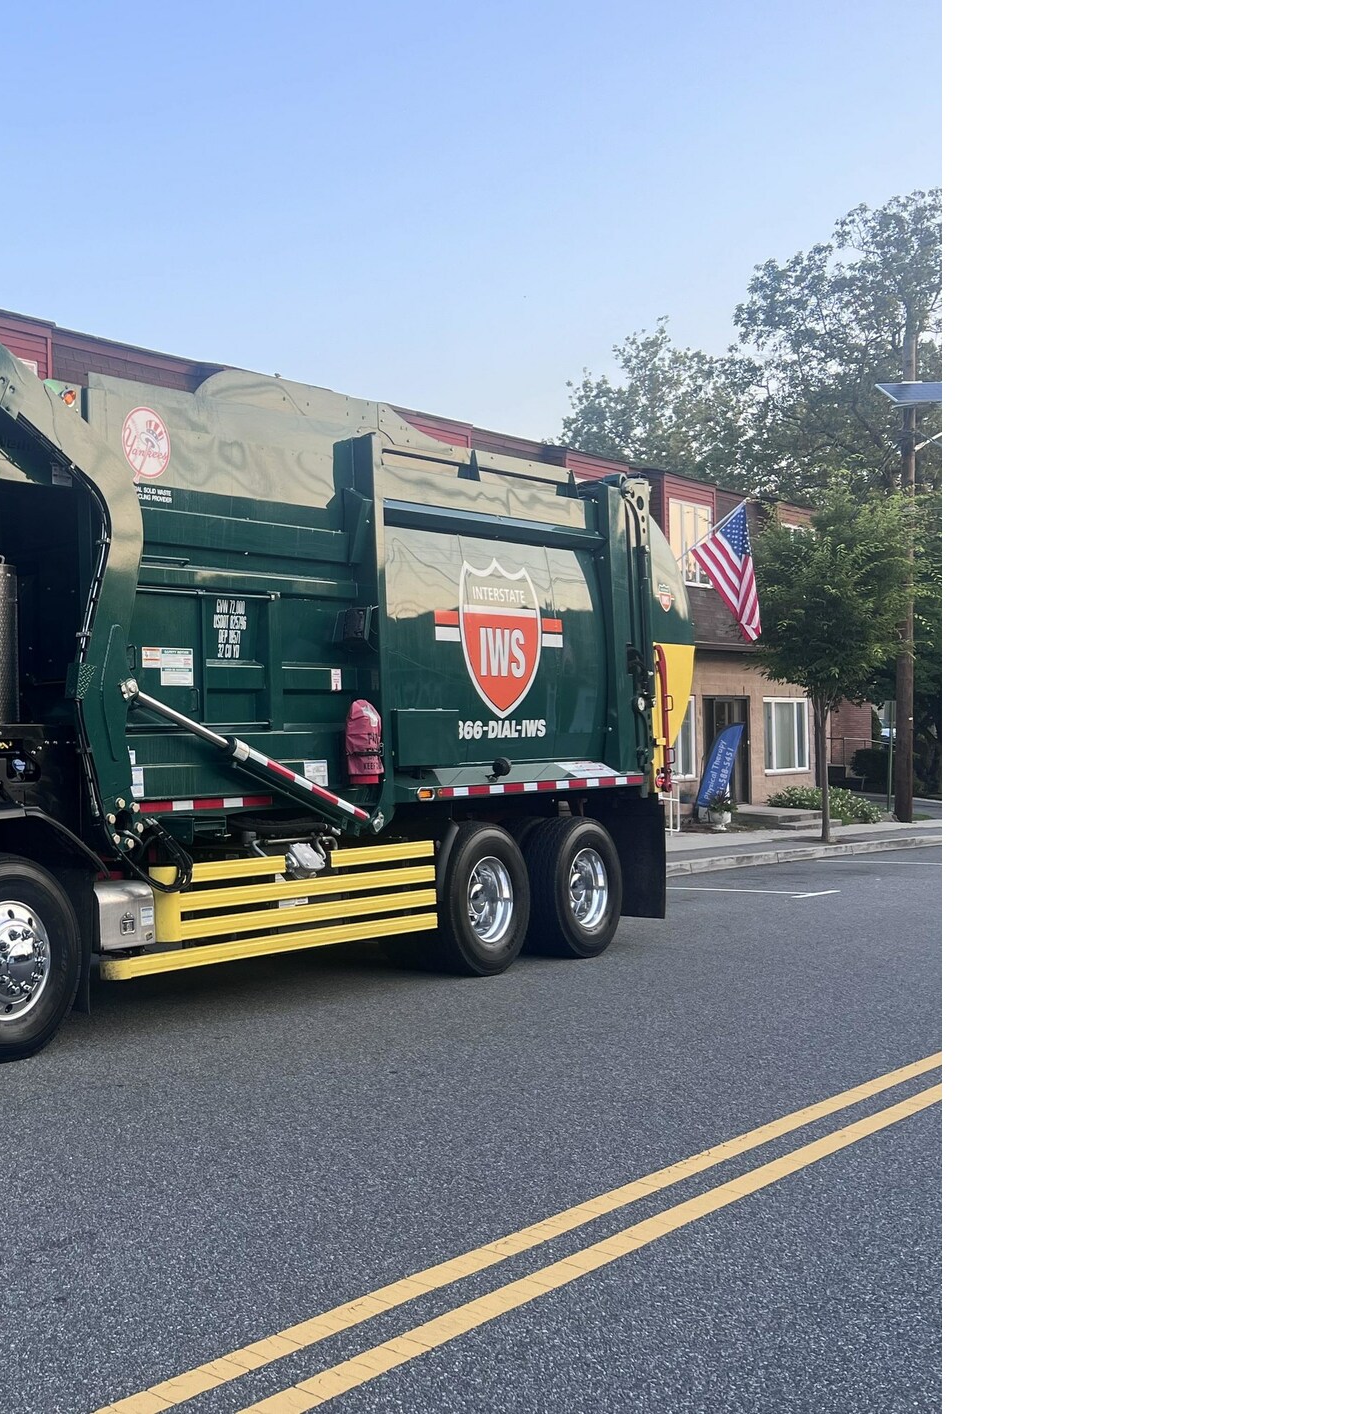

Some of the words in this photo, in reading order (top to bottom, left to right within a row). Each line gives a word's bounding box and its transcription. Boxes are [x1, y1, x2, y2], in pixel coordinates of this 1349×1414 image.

[124, 424, 168, 460] Yankees
[152, 495, 172, 503] PROVIDER
[472, 586, 526, 603] INTERSTATE
[216, 599, 228, 613] GVW
[213, 614, 229, 628] USDOT
[218, 630, 228, 643] DEP
[218, 644, 224, 658] 32
[225, 644, 232, 658] CU
[233, 644, 240, 658] YD
[479, 626, 526, 678] IWS
[704, 770, 718, 800] Physical
[711, 740, 727, 770] Therapy
